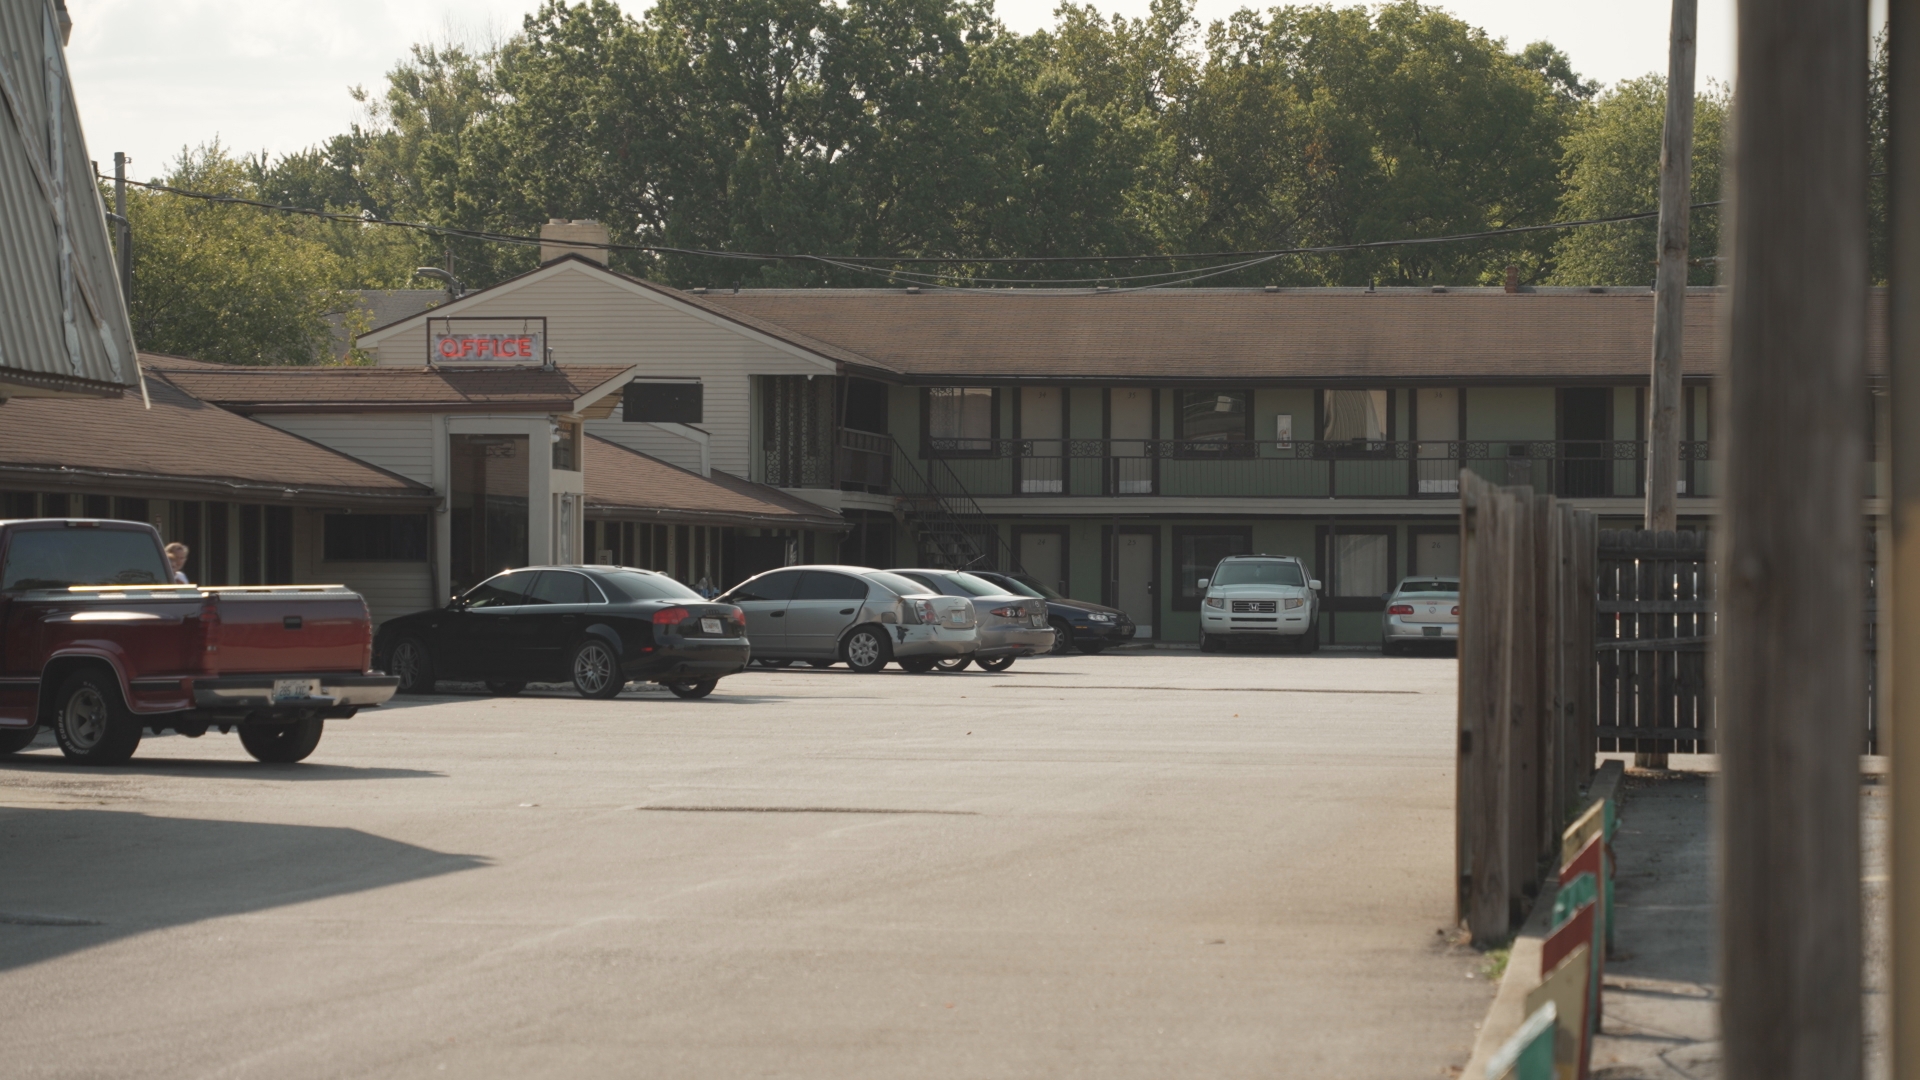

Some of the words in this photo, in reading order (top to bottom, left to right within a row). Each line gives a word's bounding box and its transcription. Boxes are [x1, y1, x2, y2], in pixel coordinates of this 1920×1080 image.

[439, 337, 533, 358] OFFICE
[1038, 391, 1047, 399] 34
[1127, 391, 1137, 399] 35
[1434, 391, 1443, 399] 36
[1037, 538, 1046, 546] 24
[1431, 541, 1441, 549] 26
[57, 709, 67, 740] COBRA
